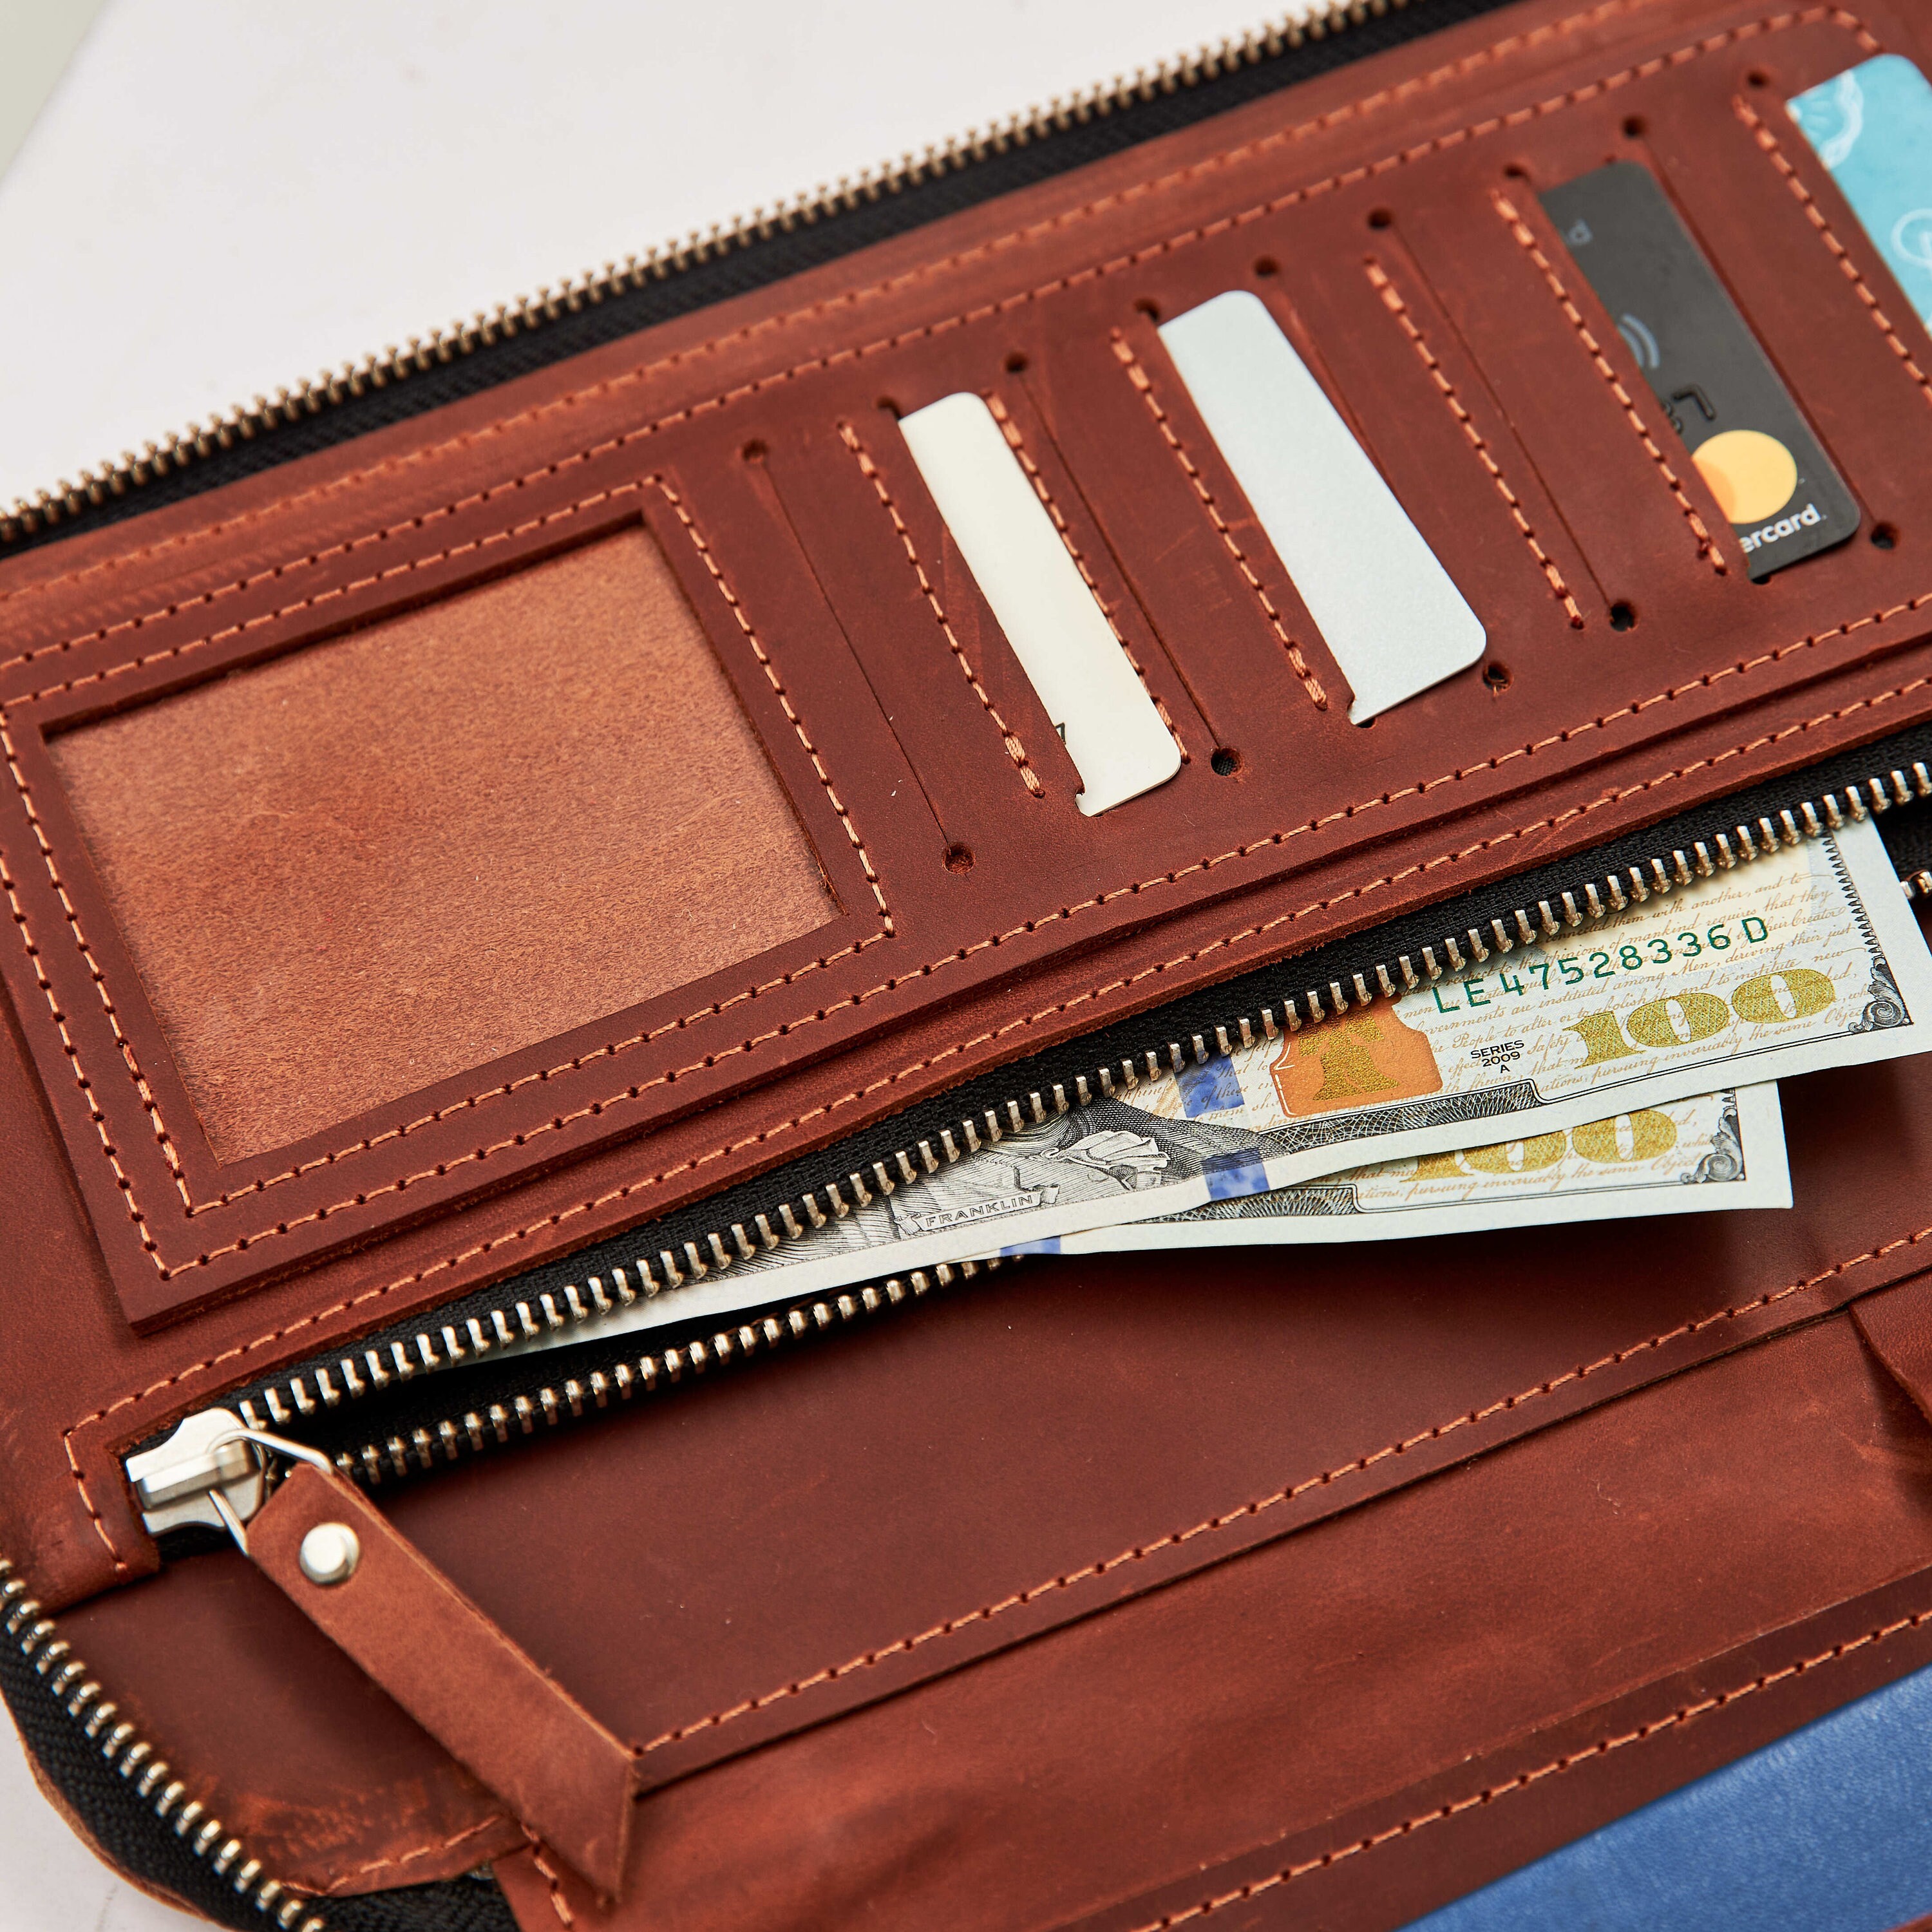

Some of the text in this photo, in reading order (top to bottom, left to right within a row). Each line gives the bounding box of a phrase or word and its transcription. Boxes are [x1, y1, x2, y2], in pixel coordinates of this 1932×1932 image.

[1739, 503, 1821, 553] ercard
[1609, 933, 1625, 954] of
[1628, 913, 1701, 944] mankind
[1763, 893, 1795, 912] that
[1801, 885, 1833, 907] they
[1613, 911, 1643, 927] them
[1653, 898, 1685, 918] with
[1692, 887, 1751, 909] another,
[1755, 876, 1784, 893] and
[1511, 1005, 1535, 1015] are
[1613, 972, 1665, 989] among
[1792, 930, 1823, 947] their
[1404, 1005, 1433, 1019] men
[1452, 1026, 1496, 1049] People
[1504, 1025, 1519, 1038] to
[1521, 1015, 1553, 1034] alter
[1560, 1014, 1572, 1023] or
[1679, 970, 1714, 996] and
[1718, 972, 1731, 985] to
[1562, 968, 1835, 1069] 100
[1470, 1040, 1525, 1059] SERIES
[1481, 1051, 1521, 1067] 2009
[1500, 1065, 1511, 1074] A
[1540, 1074, 1588, 1093] ations,
[1749, 1023, 1772, 1041] the
[1824, 1005, 1864, 1027] Objec
[925, 1195, 1034, 1227] FRANKLIN
